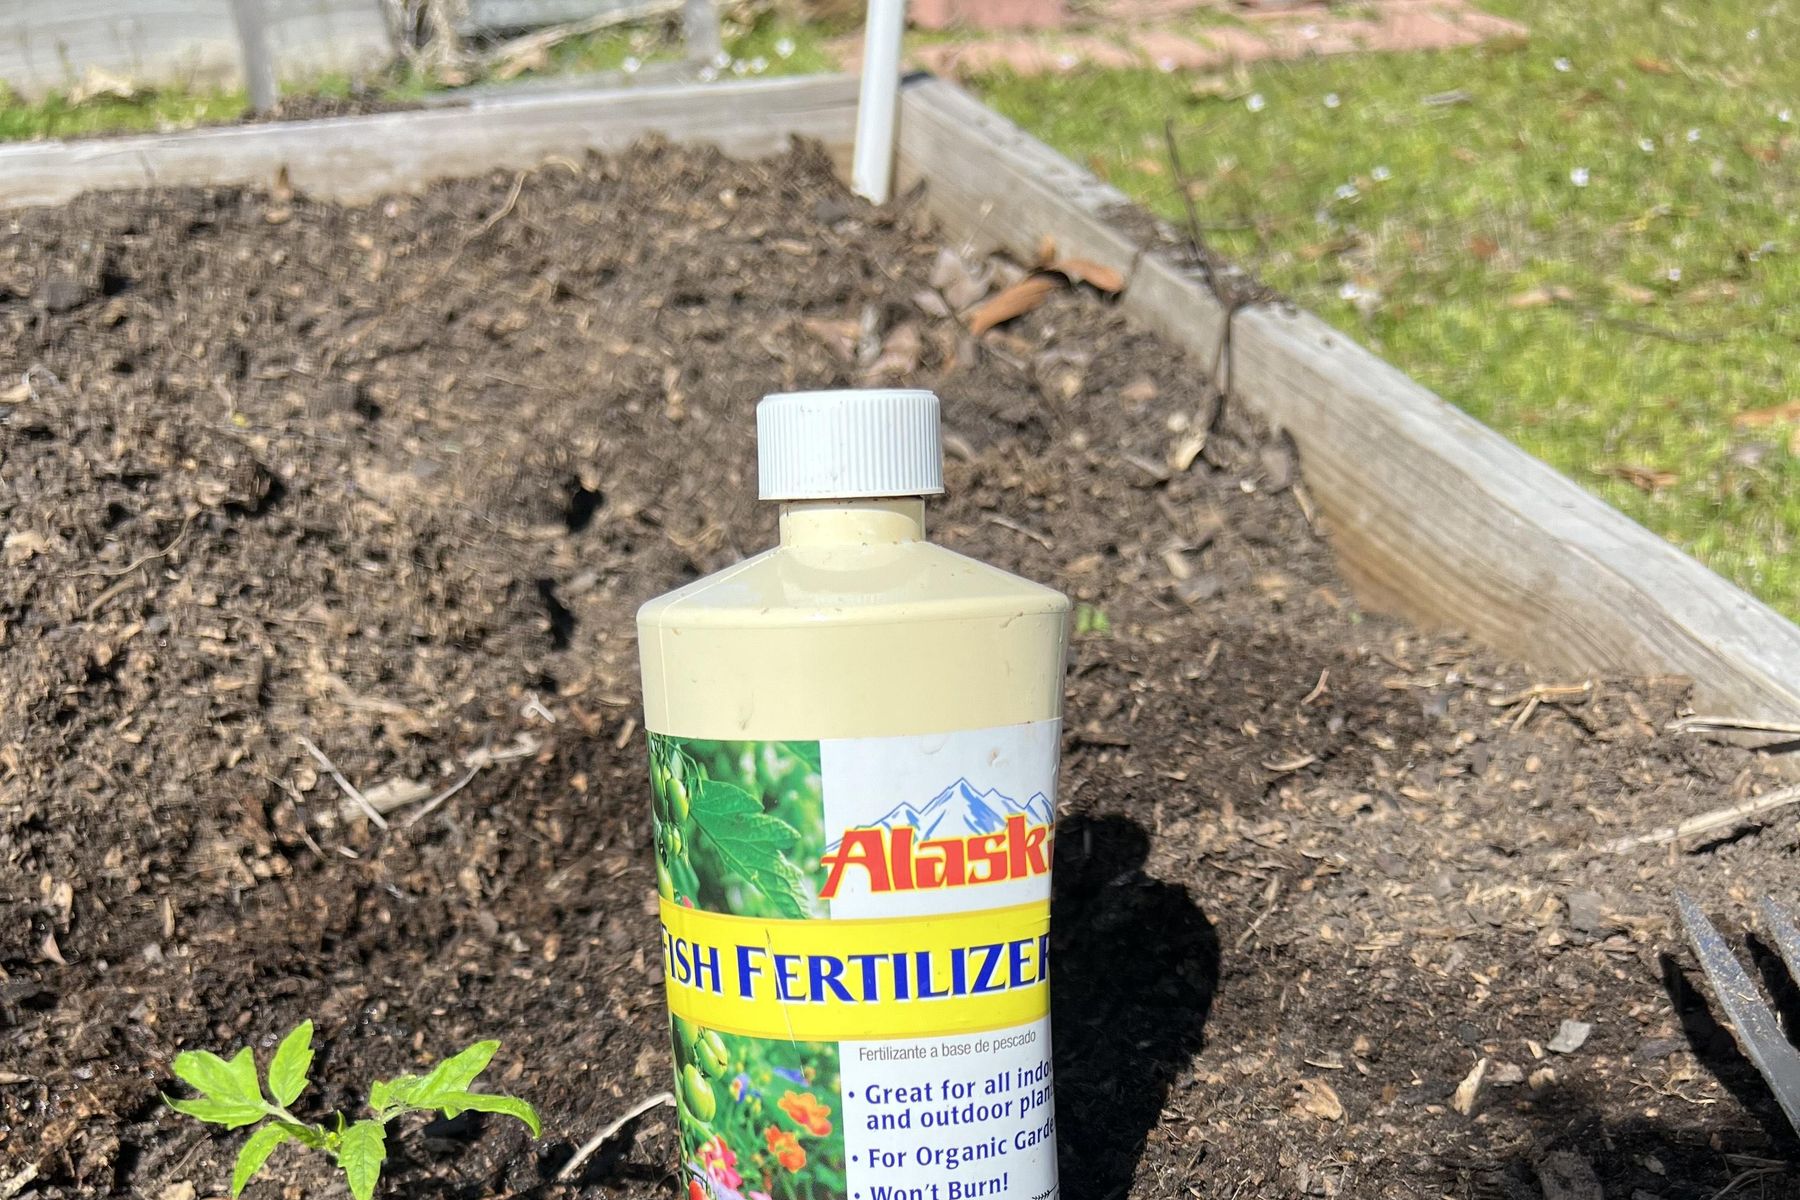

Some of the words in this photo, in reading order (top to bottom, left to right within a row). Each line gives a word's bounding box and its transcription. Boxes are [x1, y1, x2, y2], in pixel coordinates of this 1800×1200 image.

[859, 1047, 927, 1061] Fertilizante
[930, 1048, 938, 1057] a
[942, 1043, 971, 1057] base
[975, 1038, 989, 1053] de
[993, 1030, 1036, 1052] pescado
[865, 1083, 933, 1104] Great
[941, 1079, 976, 1101] for
[984, 1071, 1010, 1096] all
[867, 1109, 911, 1130] and
[921, 1100, 1013, 1128] outdoor
[868, 1148, 907, 1168] For
[916, 1136, 1007, 1169] Organic
[1014, 1116, 1056, 1150] Garde
[948, 1172, 1008, 1200] Burn!
